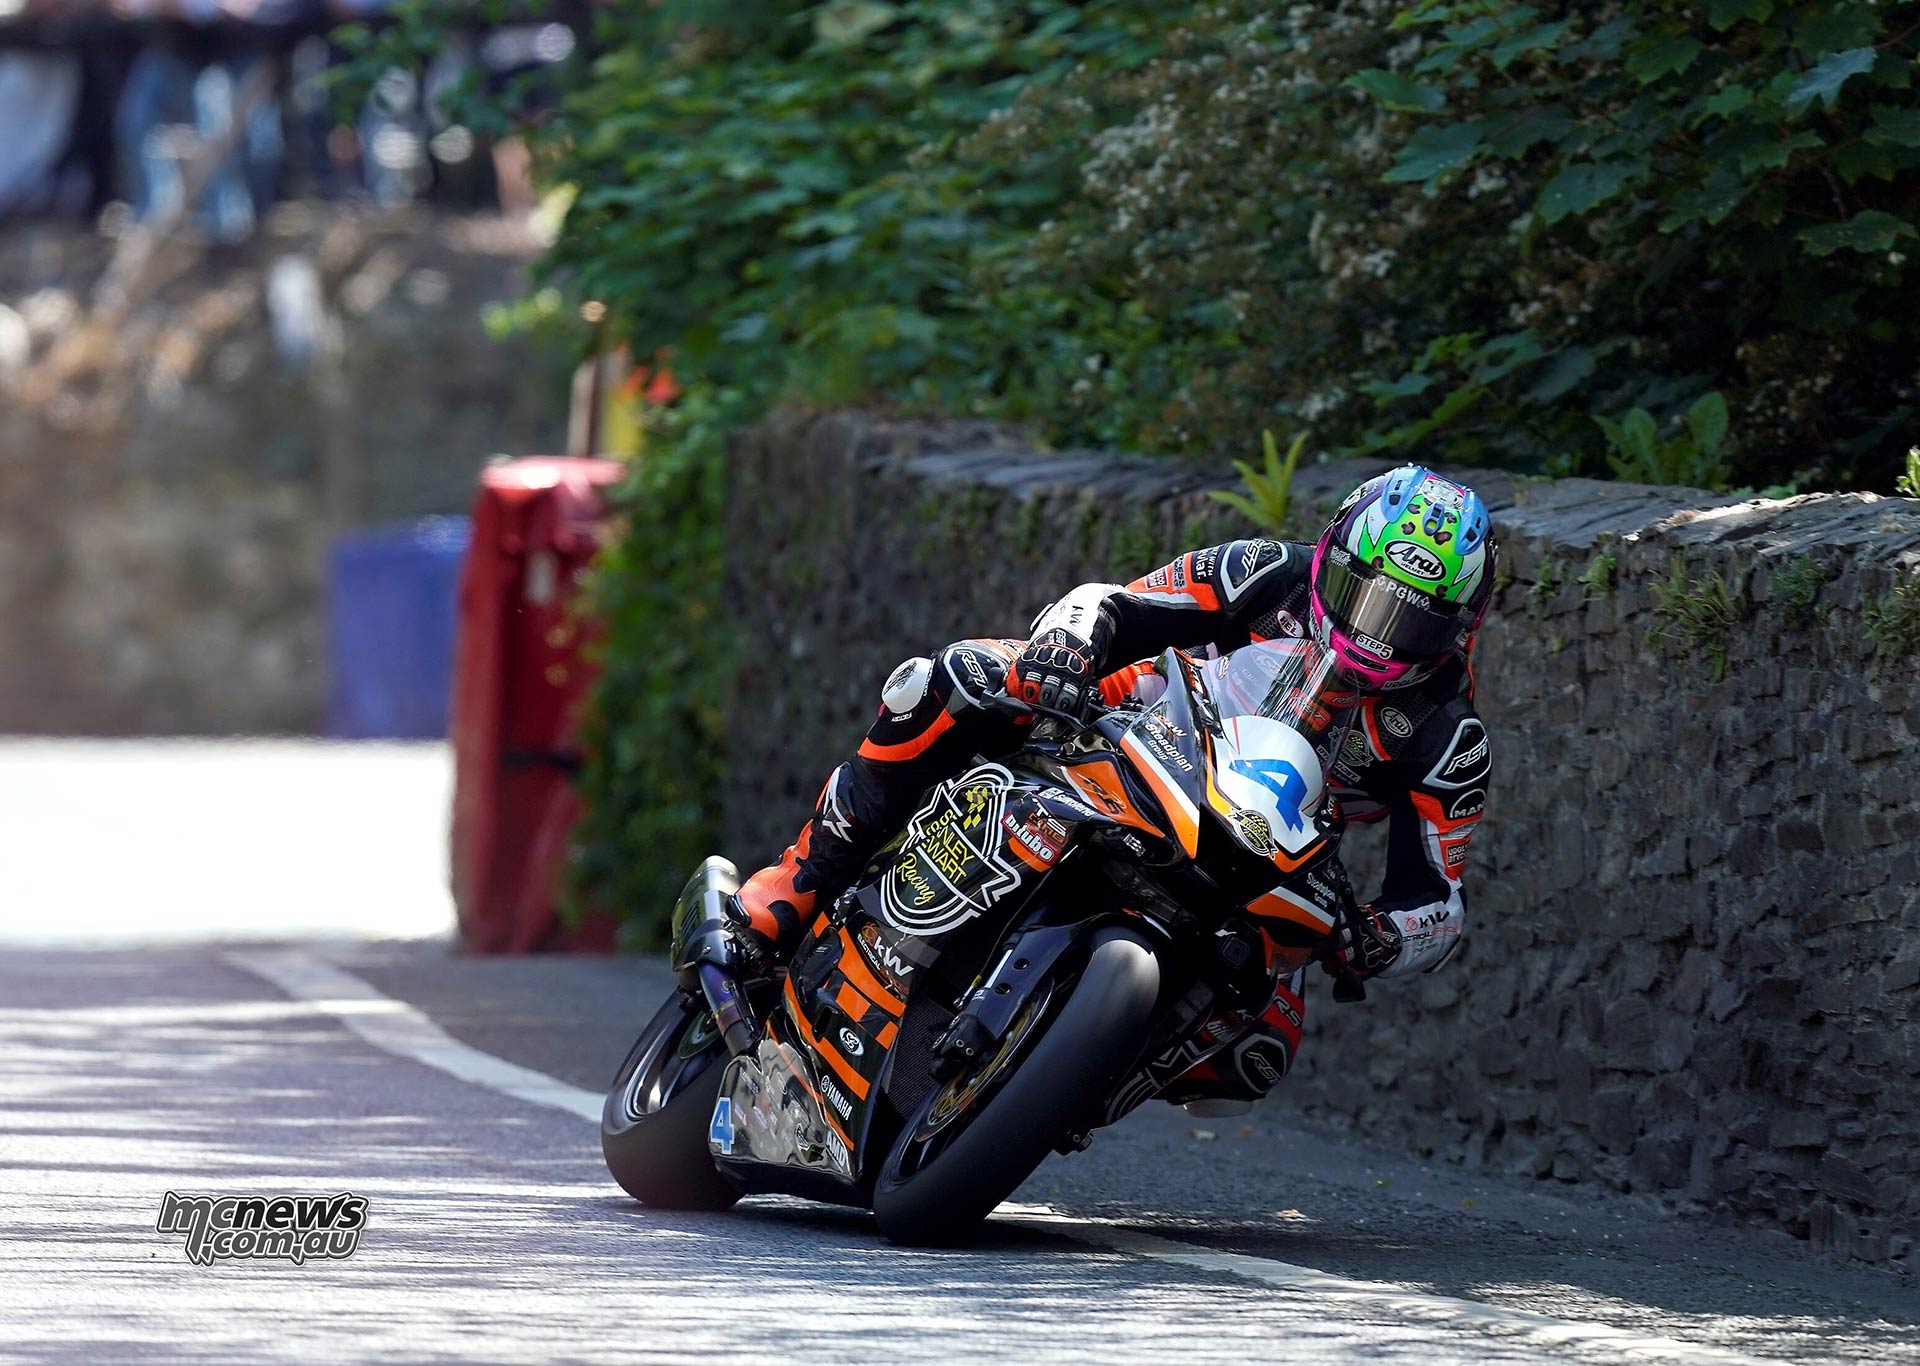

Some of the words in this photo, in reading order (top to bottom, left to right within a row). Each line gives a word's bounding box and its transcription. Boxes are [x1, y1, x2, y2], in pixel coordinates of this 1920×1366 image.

[1387, 545, 1443, 576] Arai
[1385, 582, 1420, 605] PGW
[1280, 616, 1297, 635] HEL
[956, 650, 988, 688] RST
[1144, 723, 1193, 773] Steadplan
[1148, 739, 1170, 762] Group
[1444, 736, 1488, 776] RST
[1228, 758, 1308, 834] 4
[898, 852, 935, 906] Racing
[857, 934, 882, 971] ELECTRICAL
[872, 936, 914, 976] kW
[827, 1078, 853, 1121] YAMAHA
[711, 1097, 735, 1154] 4
